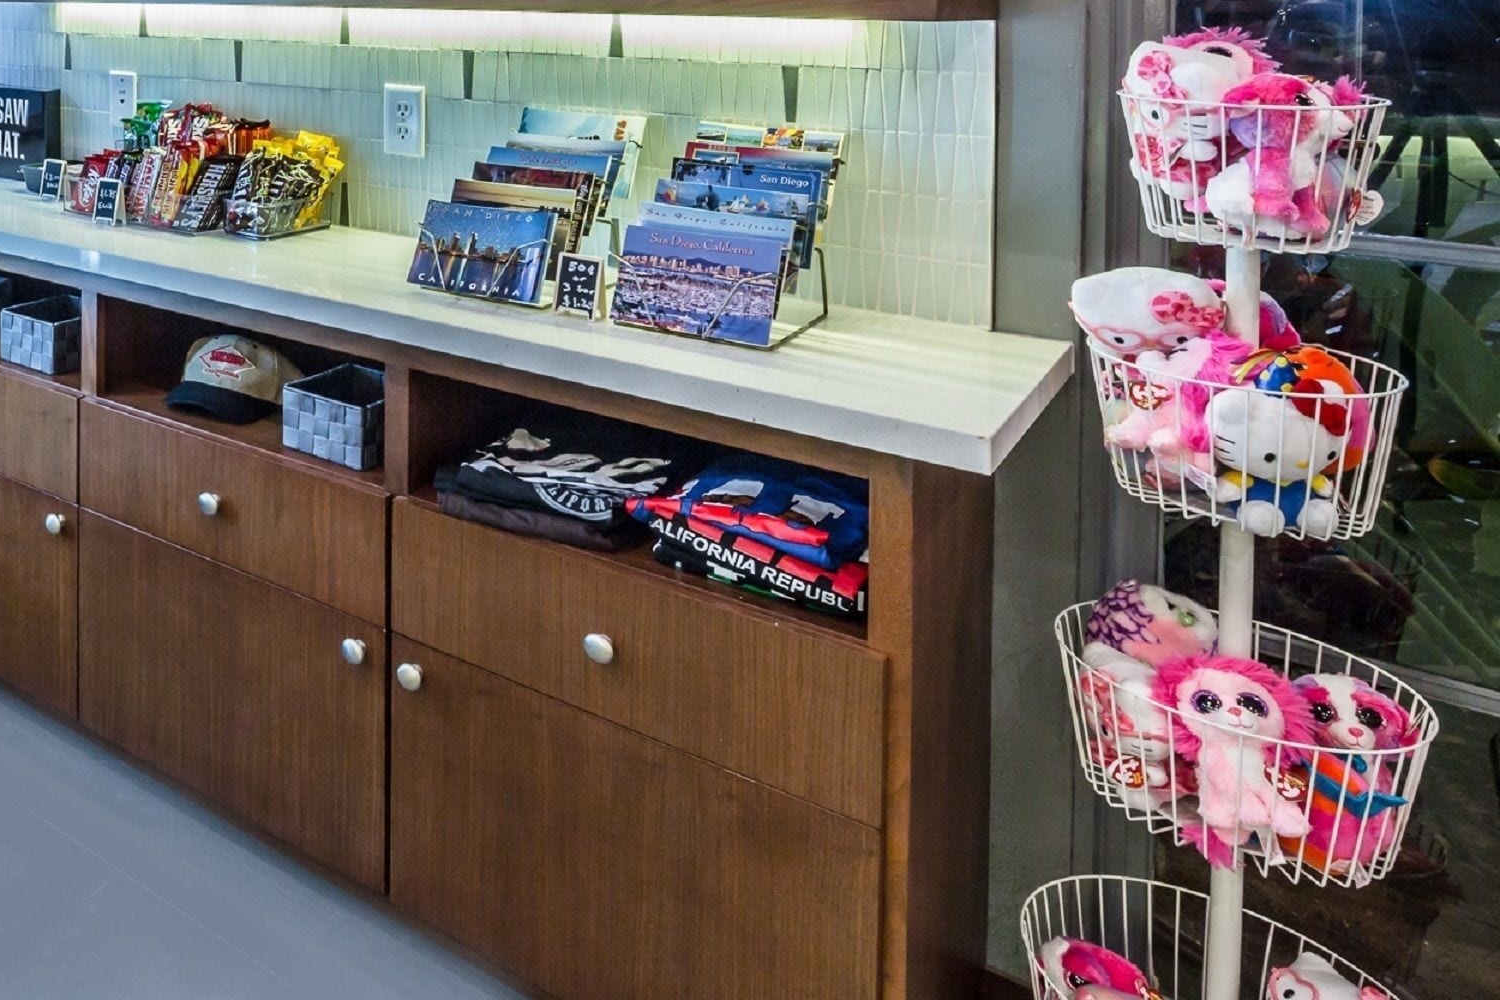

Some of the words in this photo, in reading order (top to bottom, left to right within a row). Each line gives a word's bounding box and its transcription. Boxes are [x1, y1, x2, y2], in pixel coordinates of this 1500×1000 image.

[760, 174, 778, 184] San
[780, 176, 810, 189] Diego
[650, 232, 668, 246] San
[703, 239, 755, 256] California
[649, 517, 756, 575] ALIFORNIA
